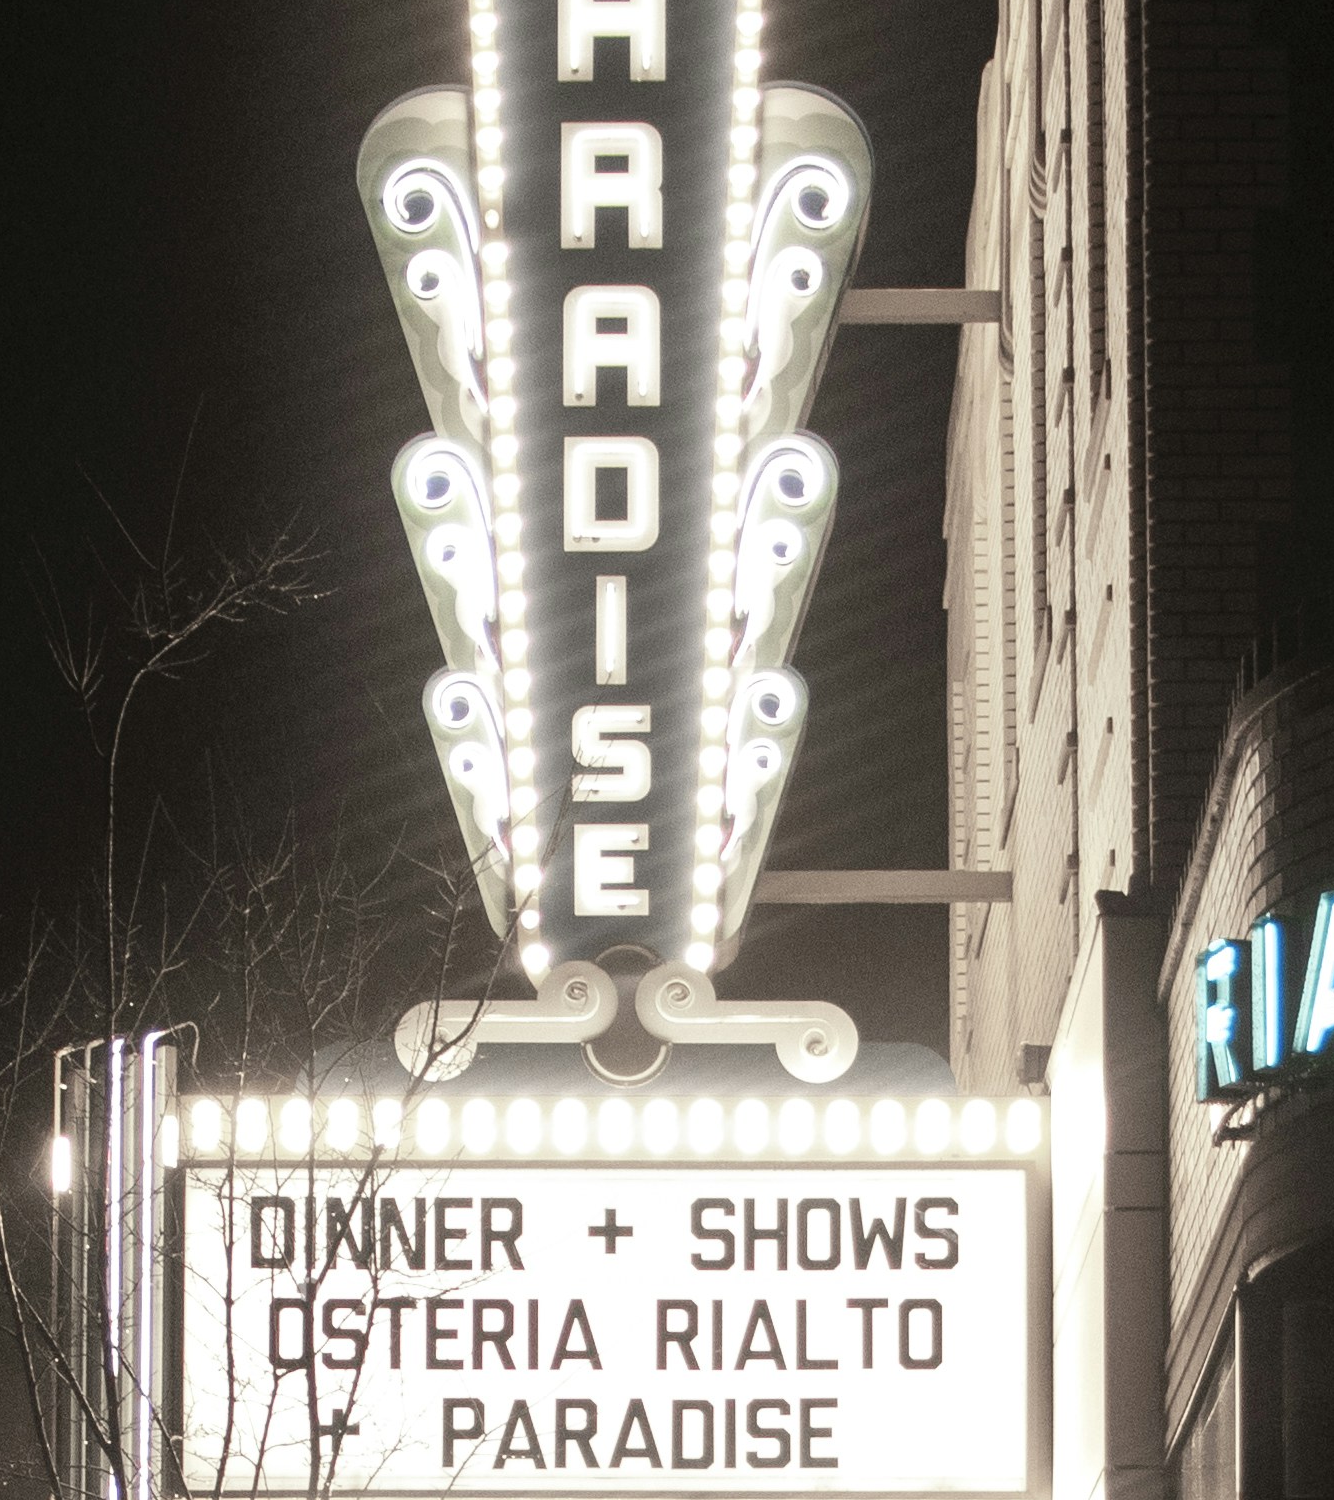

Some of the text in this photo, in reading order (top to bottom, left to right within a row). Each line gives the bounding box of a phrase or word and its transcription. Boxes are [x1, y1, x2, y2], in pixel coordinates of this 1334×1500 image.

[250, 1196, 961, 1272] DINNER + SHOWS
[267, 1298, 944, 1372] OSTERIA RIALTO
[442, 1396, 840, 1470] PARADISE
